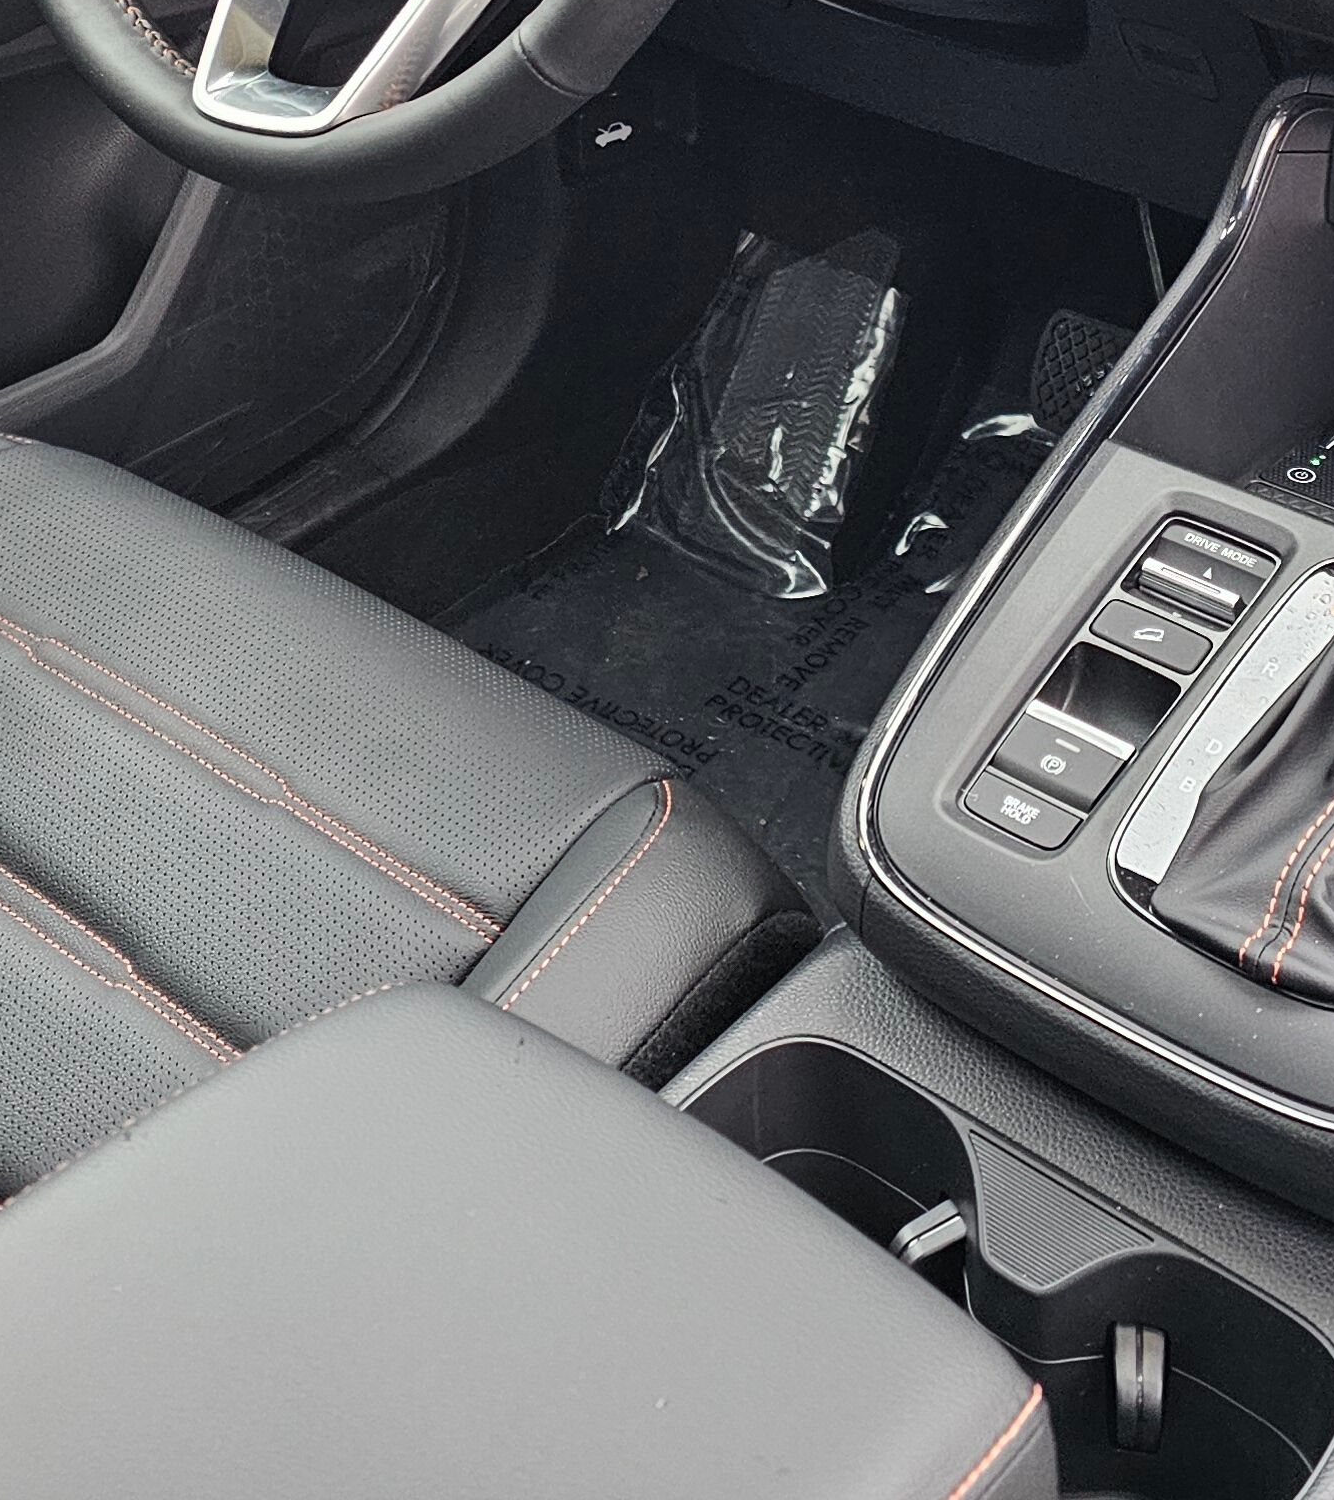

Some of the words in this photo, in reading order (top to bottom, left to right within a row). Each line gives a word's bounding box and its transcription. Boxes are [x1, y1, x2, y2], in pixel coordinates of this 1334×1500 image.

[1183, 530, 1219, 556] DRIVE
[1219, 543, 1259, 569] MODE
[1204, 740, 1223, 757] D
[1178, 778, 1196, 795] B
[999, 802, 1032, 826] HOLD
[1002, 795, 1041, 819] BRAKE
